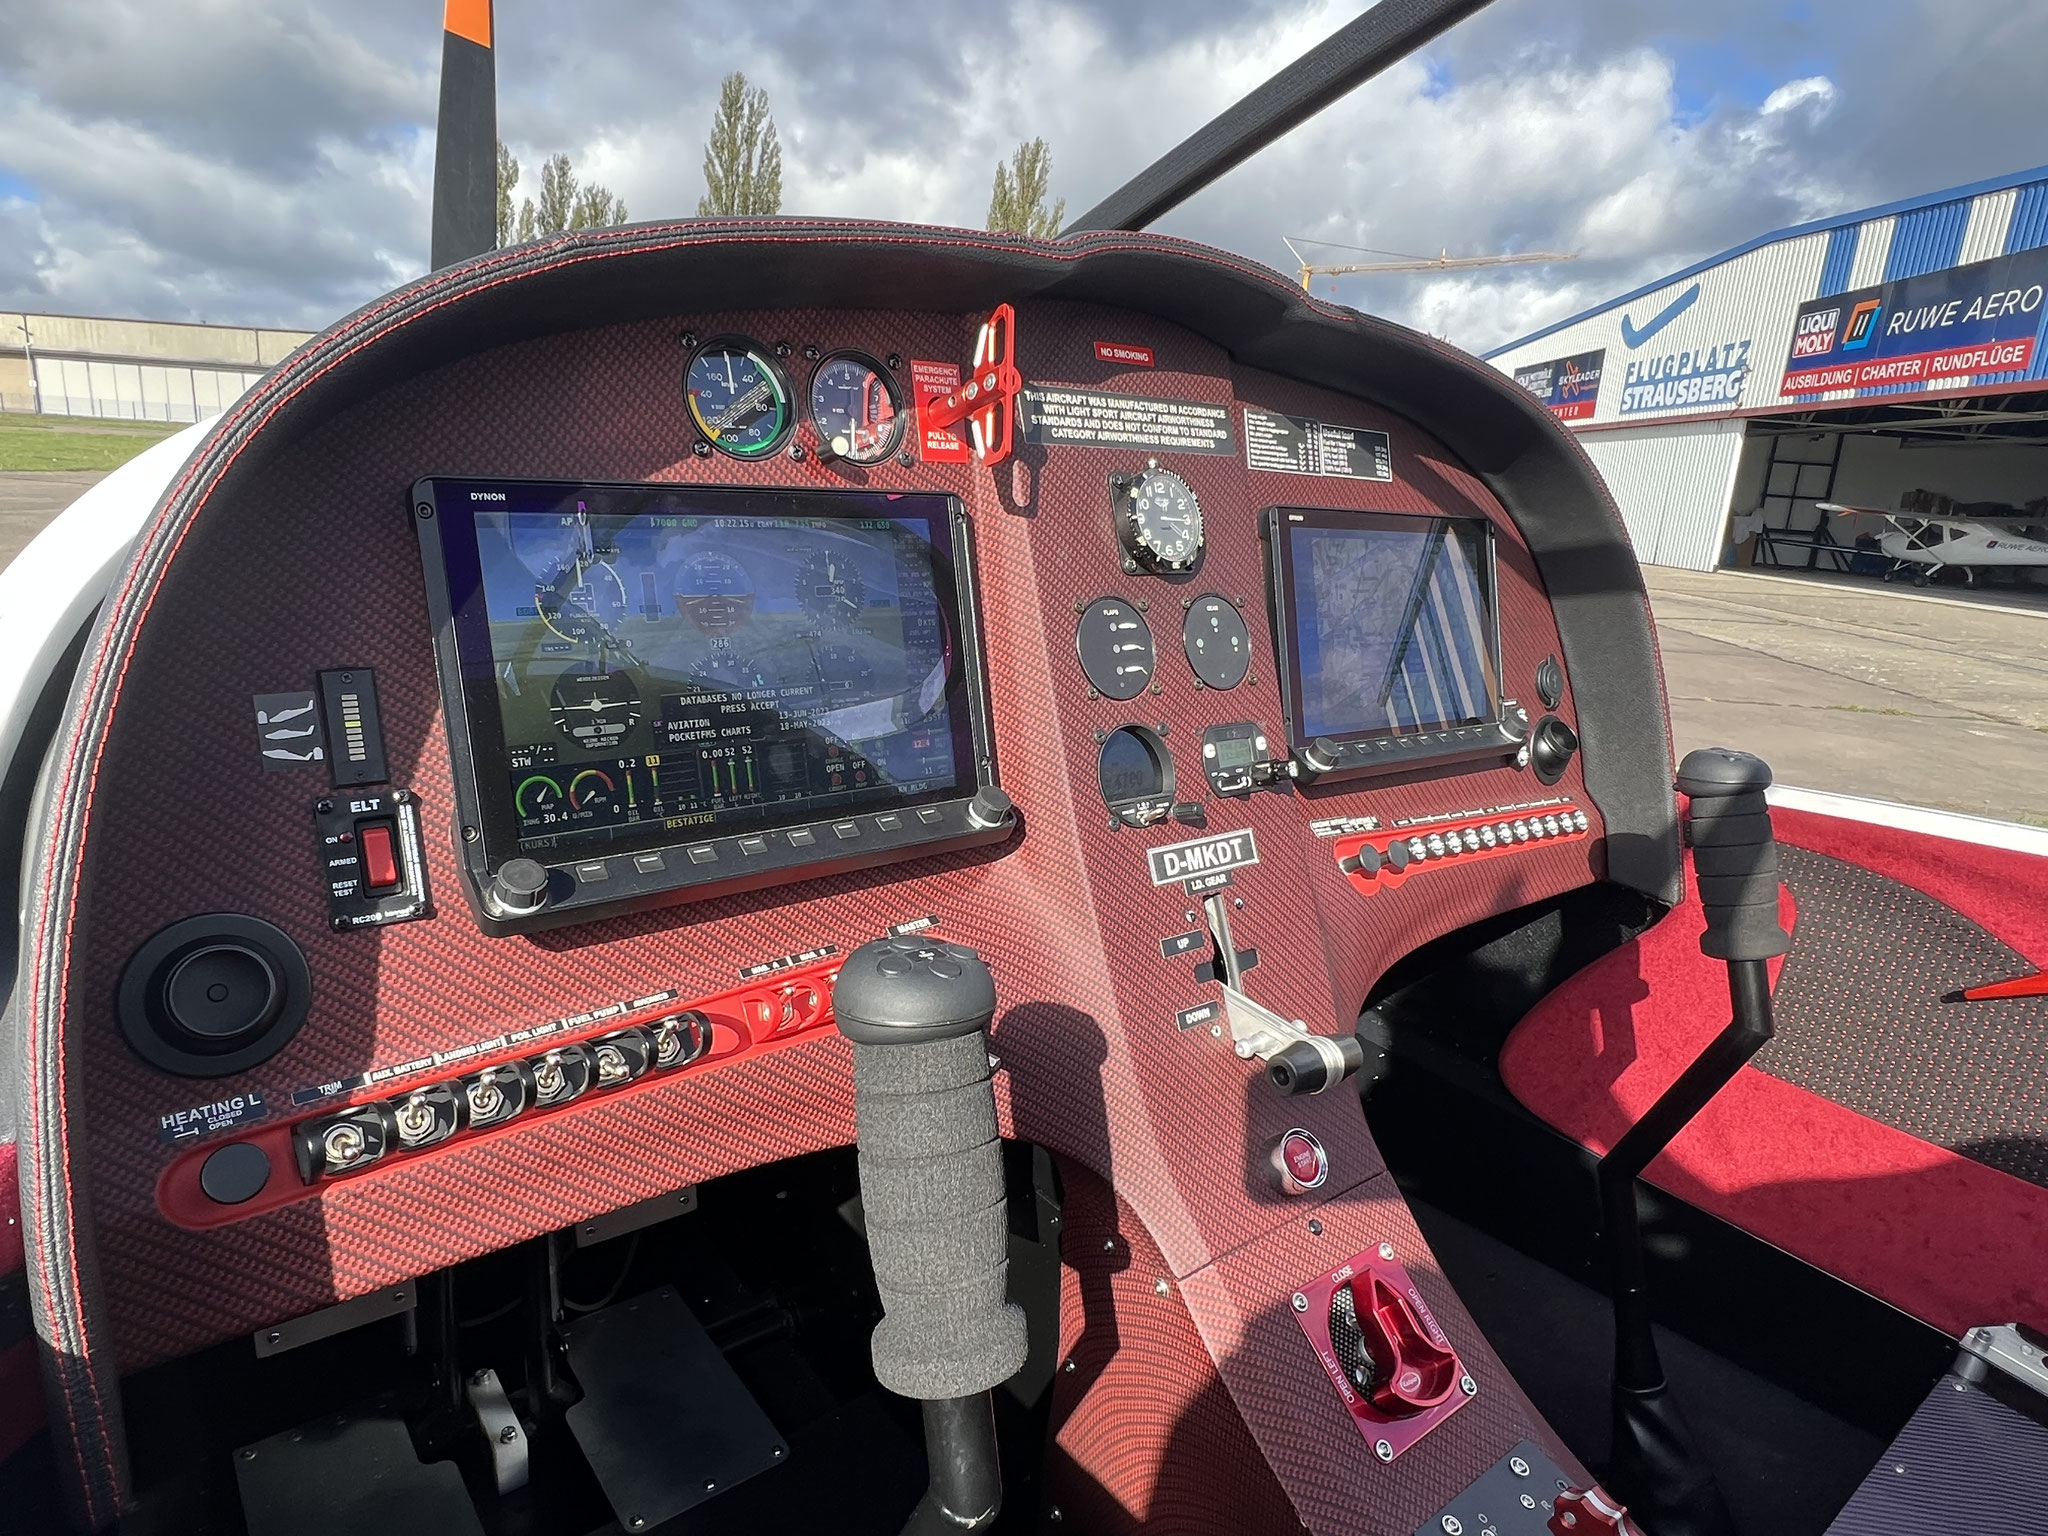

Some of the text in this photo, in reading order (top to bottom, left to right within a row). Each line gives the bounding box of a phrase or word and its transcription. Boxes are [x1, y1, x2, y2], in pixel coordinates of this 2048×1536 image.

[1887, 285, 2043, 336] RUWE AERO
[1800, 311, 1836, 334] LIQUI
[1796, 332, 1834, 354] MOLY
[1100, 347, 1149, 362] NO SMOKING
[1626, 340, 1751, 384] FLUGPLATZ
[1784, 345, 2025, 390] AUSBILDUNG CHARTER RUNDFLÜGE
[913, 365, 958, 376] EMERGENCY
[742, 375, 753, 383] 40
[915, 374, 958, 385] PARACHUTE
[1558, 369, 1600, 386] SKYLEADER
[923, 384, 952, 394] SYSTEM
[1621, 370, 1742, 411] STRAUSBERG
[1024, 390, 1226, 419] THIS AIRCRAFT WAS MANUFACTURED IN ACCORDANCE
[1042, 404, 1215, 428] WITH LIGHT SPORT AIRCRAFT AIRWORTHINESS
[1551, 406, 1579, 417] ENTER
[1031, 414, 1228, 440] STANDARDS AND DOES NOT CONFORM TO STANDARD
[722, 434, 738, 442] 100
[927, 431, 946, 440] PULL
[1051, 428, 1215, 449] CATEGORY AIRWORTHINESS REQUIREMENTS
[927, 441, 959, 450] RELEASE
[1154, 482, 1165, 493] 12
[470, 492, 506, 501] DYNON
[1139, 499, 1149, 510] 10
[1177, 499, 1185, 510] 2
[561, 517, 573, 526] AP
[1138, 513, 1145, 524] 9
[1183, 515, 1191, 525] 3
[1143, 529, 1151, 540] 8
[1181, 530, 1189, 540] 4
[1153, 541, 1161, 552] 7
[1166, 545, 1173, 556] 6
[1176, 541, 1183, 551] 5
[547, 612, 561, 620] 120
[680, 686, 814, 706] DATABASES NO LONGER CURRENT
[720, 700, 779, 714] PRESS ACCEPT
[628, 718, 635, 726] R
[667, 719, 710, 731] AVIATION
[669, 726, 751, 743] POCKETFMS CHARTS
[702, 749, 723, 759] 0.00
[725, 747, 735, 757] 52
[742, 745, 752, 754] 52
[511, 757, 531, 768] STW
[618, 759, 636, 769] 0.2
[852, 761, 866, 769] OFF
[826, 764, 845, 773] OPEN
[350, 799, 380, 813] ELT
[541, 803, 554, 811] MAP
[613, 804, 620, 813] 0
[543, 812, 568, 823] 30.4
[325, 836, 338, 844] ON
[329, 857, 358, 868] ARMED
[1163, 838, 1242, 876] D-MKDT
[332, 879, 358, 890] RESET
[1205, 874, 1228, 886] GEAR
[334, 888, 354, 897] TEST
[896, 919, 932, 934] MASTER
[1176, 938, 1189, 949] UP
[633, 992, 670, 1008] AVIONICS
[568, 1006, 620, 1027] FUEL PUMP
[1185, 1007, 1211, 1025] DOWN
[532, 1023, 557, 1036] LIGHT
[439, 1040, 502, 1061] LANDING LIGHT
[372, 1057, 433, 1081] AUX. BATTERY
[318, 1081, 343, 1094] TRIM
[161, 1094, 261, 1129] HEATING L
[207, 1110, 243, 1124] CLOSED
[209, 1119, 234, 1131] OPEN
[1331, 1265, 1354, 1283] CLOSE
[1408, 1288, 1445, 1344] OPEN RIGHT
[1320, 1350, 1355, 1404] OPEN LEFT
